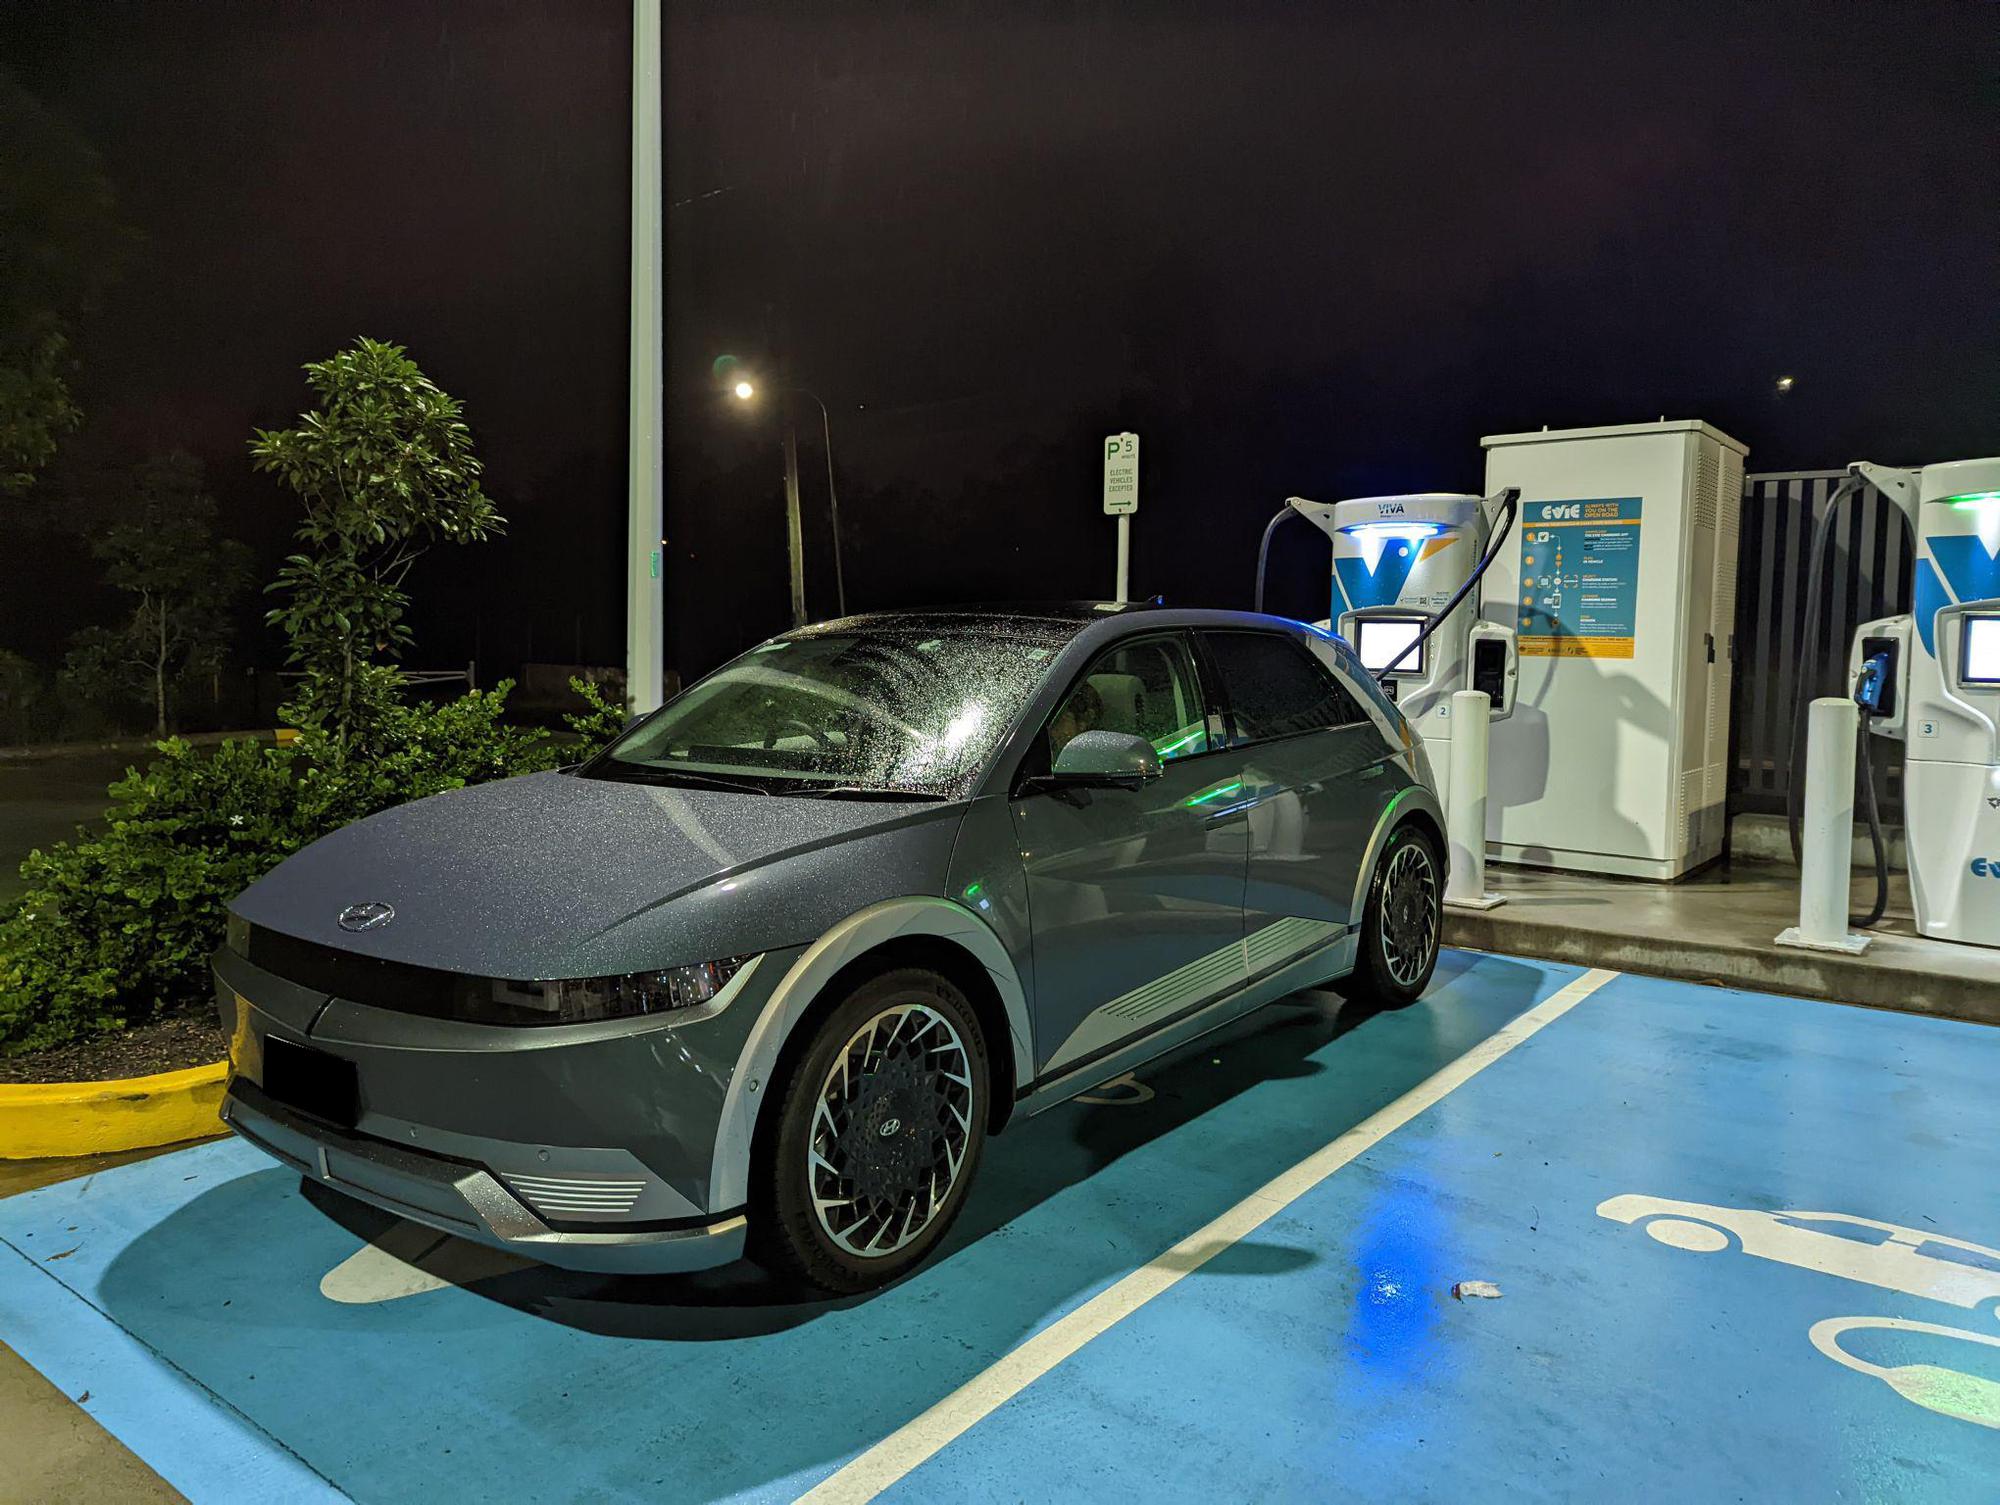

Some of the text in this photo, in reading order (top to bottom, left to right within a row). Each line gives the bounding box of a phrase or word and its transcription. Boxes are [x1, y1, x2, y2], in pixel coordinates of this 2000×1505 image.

[1108, 442, 1120, 460] P
[1126, 441, 1132, 452] 5
[1377, 503, 1405, 514] VIVA
[1440, 706, 1447, 716] 2
[1924, 724, 1932, 734] 3
